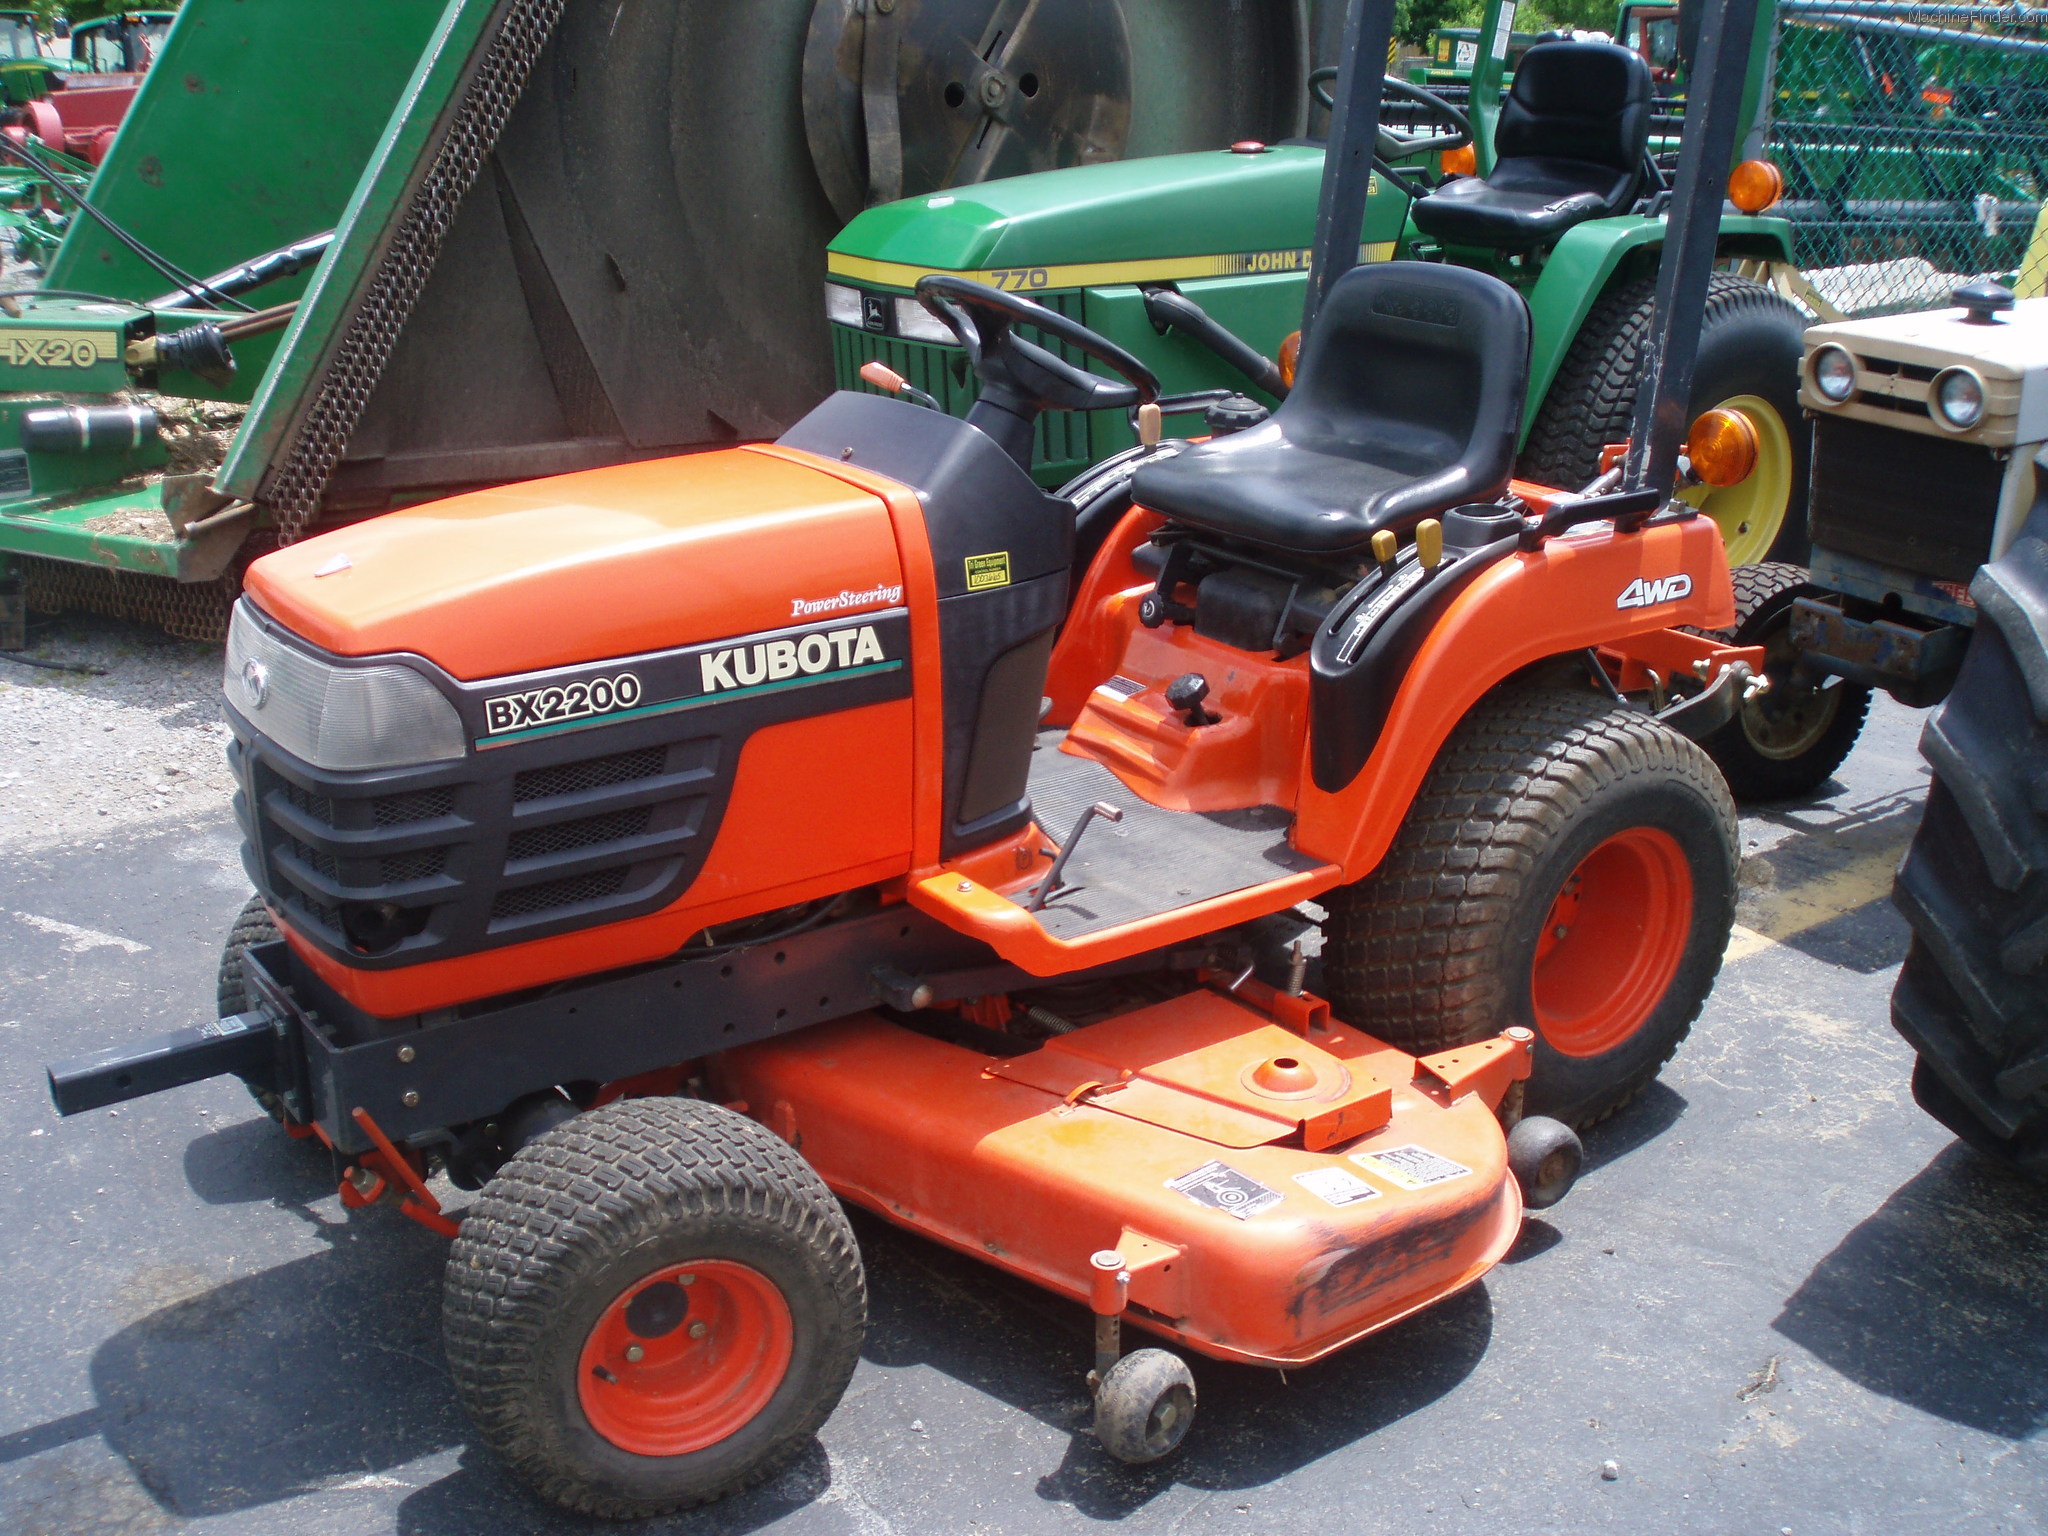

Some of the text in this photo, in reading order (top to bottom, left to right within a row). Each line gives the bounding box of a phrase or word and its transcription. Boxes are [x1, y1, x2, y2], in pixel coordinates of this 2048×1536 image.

[1247, 251, 1296, 272] JOHN
[991, 269, 1048, 289] 770
[790, 584, 902, 617] PowerSteering
[1617, 573, 1692, 609] 4WD
[701, 626, 884, 692] KUBOTA
[484, 672, 641, 734] BX2200
